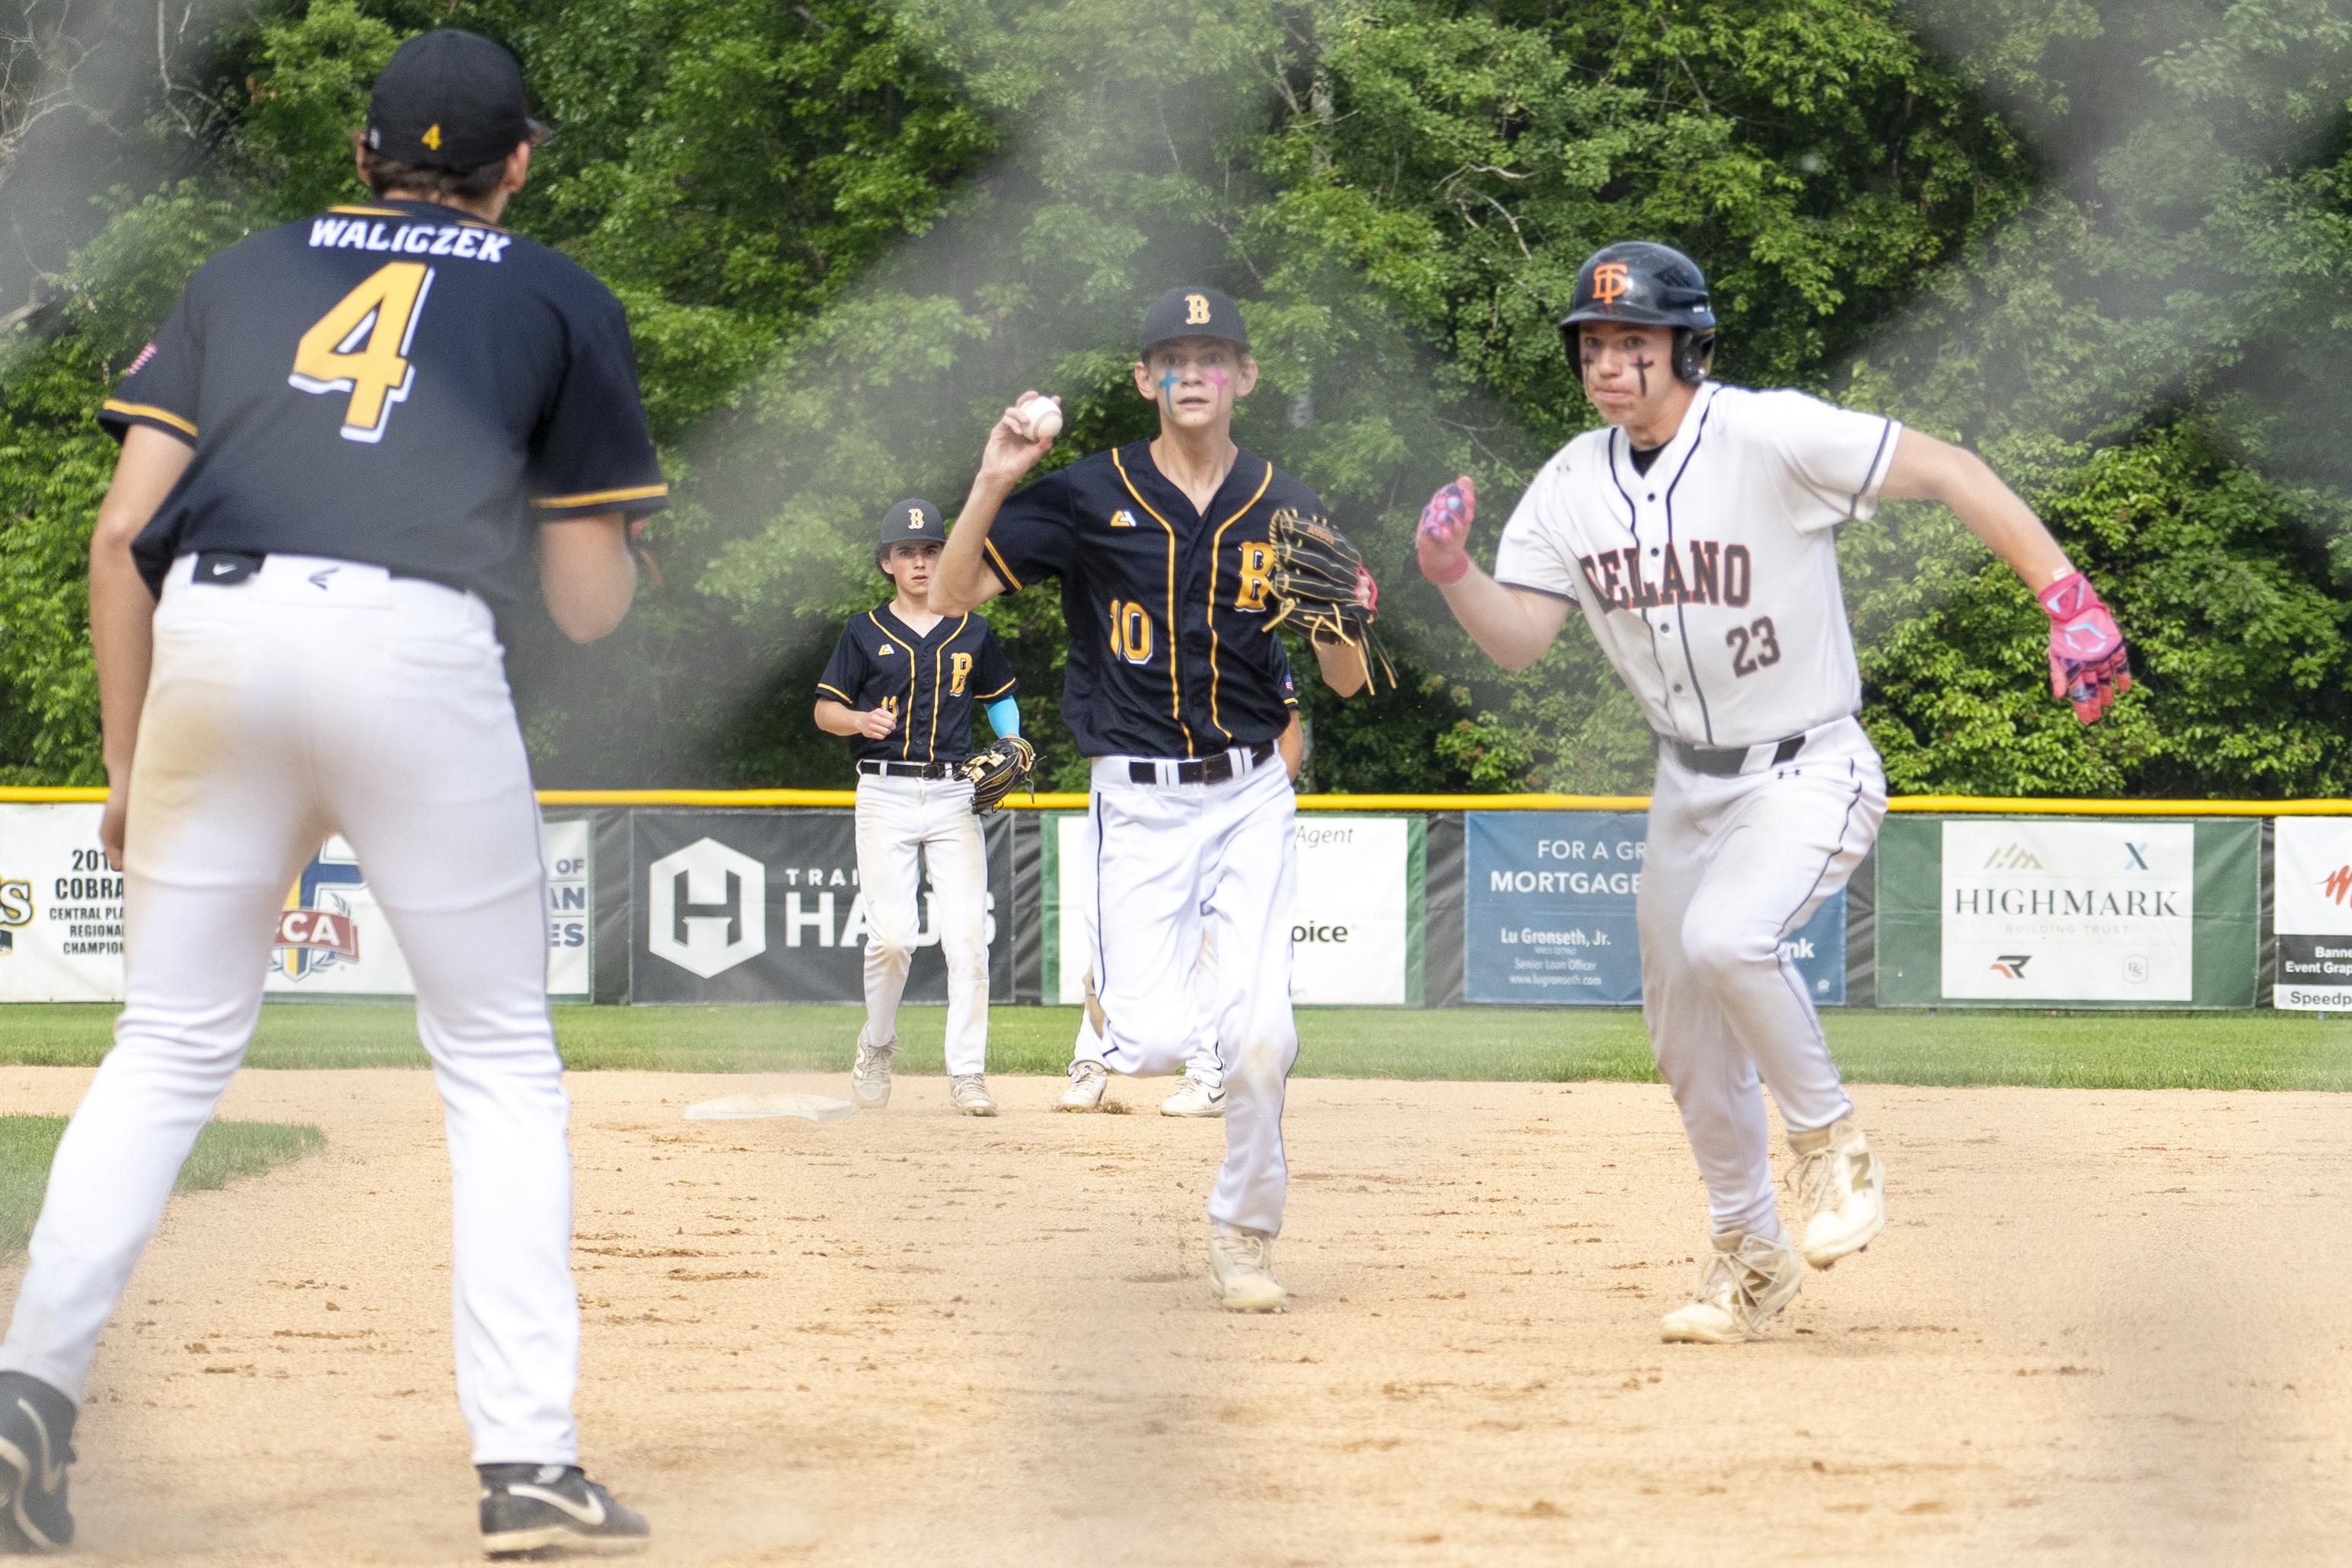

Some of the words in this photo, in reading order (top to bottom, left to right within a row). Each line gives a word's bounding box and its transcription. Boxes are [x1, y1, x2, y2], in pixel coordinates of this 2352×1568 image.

[422, 123, 441, 150] 4
[308, 218, 512, 263] WALICZEK
[1185, 295, 1211, 325] B
[288, 260, 435, 443] 4
[908, 508, 925, 529] B
[1234, 541, 1277, 613] B
[1110, 599, 1153, 664] 10
[1726, 615, 1781, 677] 23
[1296, 826, 1354, 848] Agent
[1538, 840, 1586, 859] FOR
[1592, 841, 1608, 859] A
[556, 859, 584, 875] OF
[49, 907, 101, 920] CENTRAL
[1955, 888, 2180, 916] HIGHMARK
[1500, 928, 1518, 944] Lu
[1592, 930, 1611, 946] Jr.
[2005, 924, 2076, 935] BUILDING
[2083, 925, 2130, 935] TRUST
[2286, 961, 2321, 973] Event
